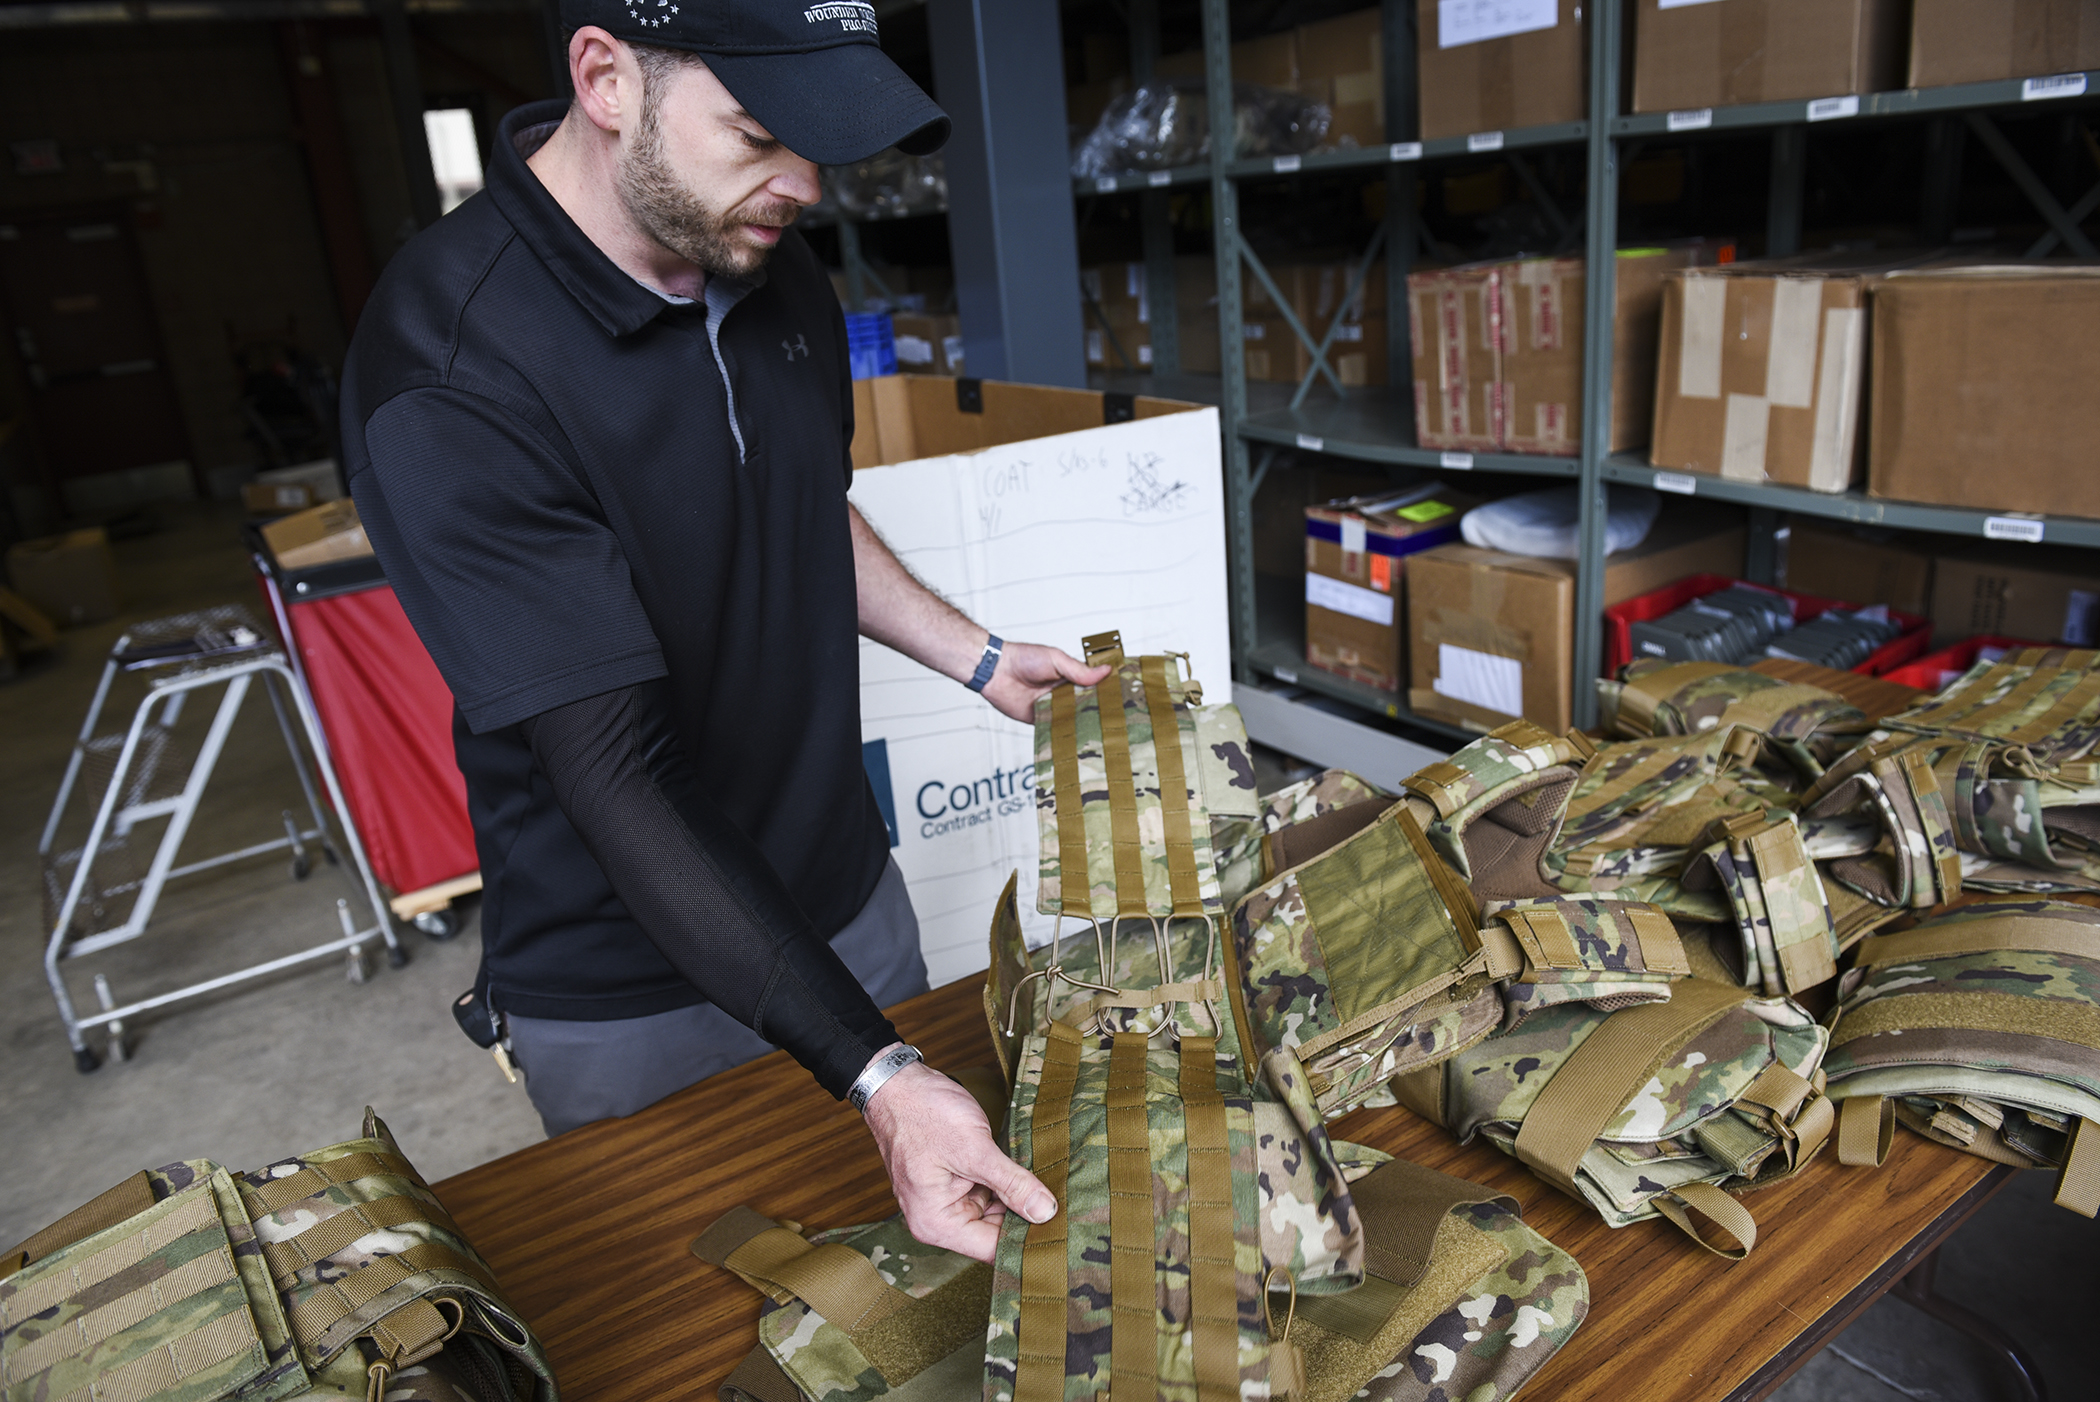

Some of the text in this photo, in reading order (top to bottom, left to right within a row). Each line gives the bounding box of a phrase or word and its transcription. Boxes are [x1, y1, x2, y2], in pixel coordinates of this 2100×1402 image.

[984, 459, 1032, 497] COAT
[916, 764, 1036, 819] Contra
[920, 807, 992, 839] Contract
